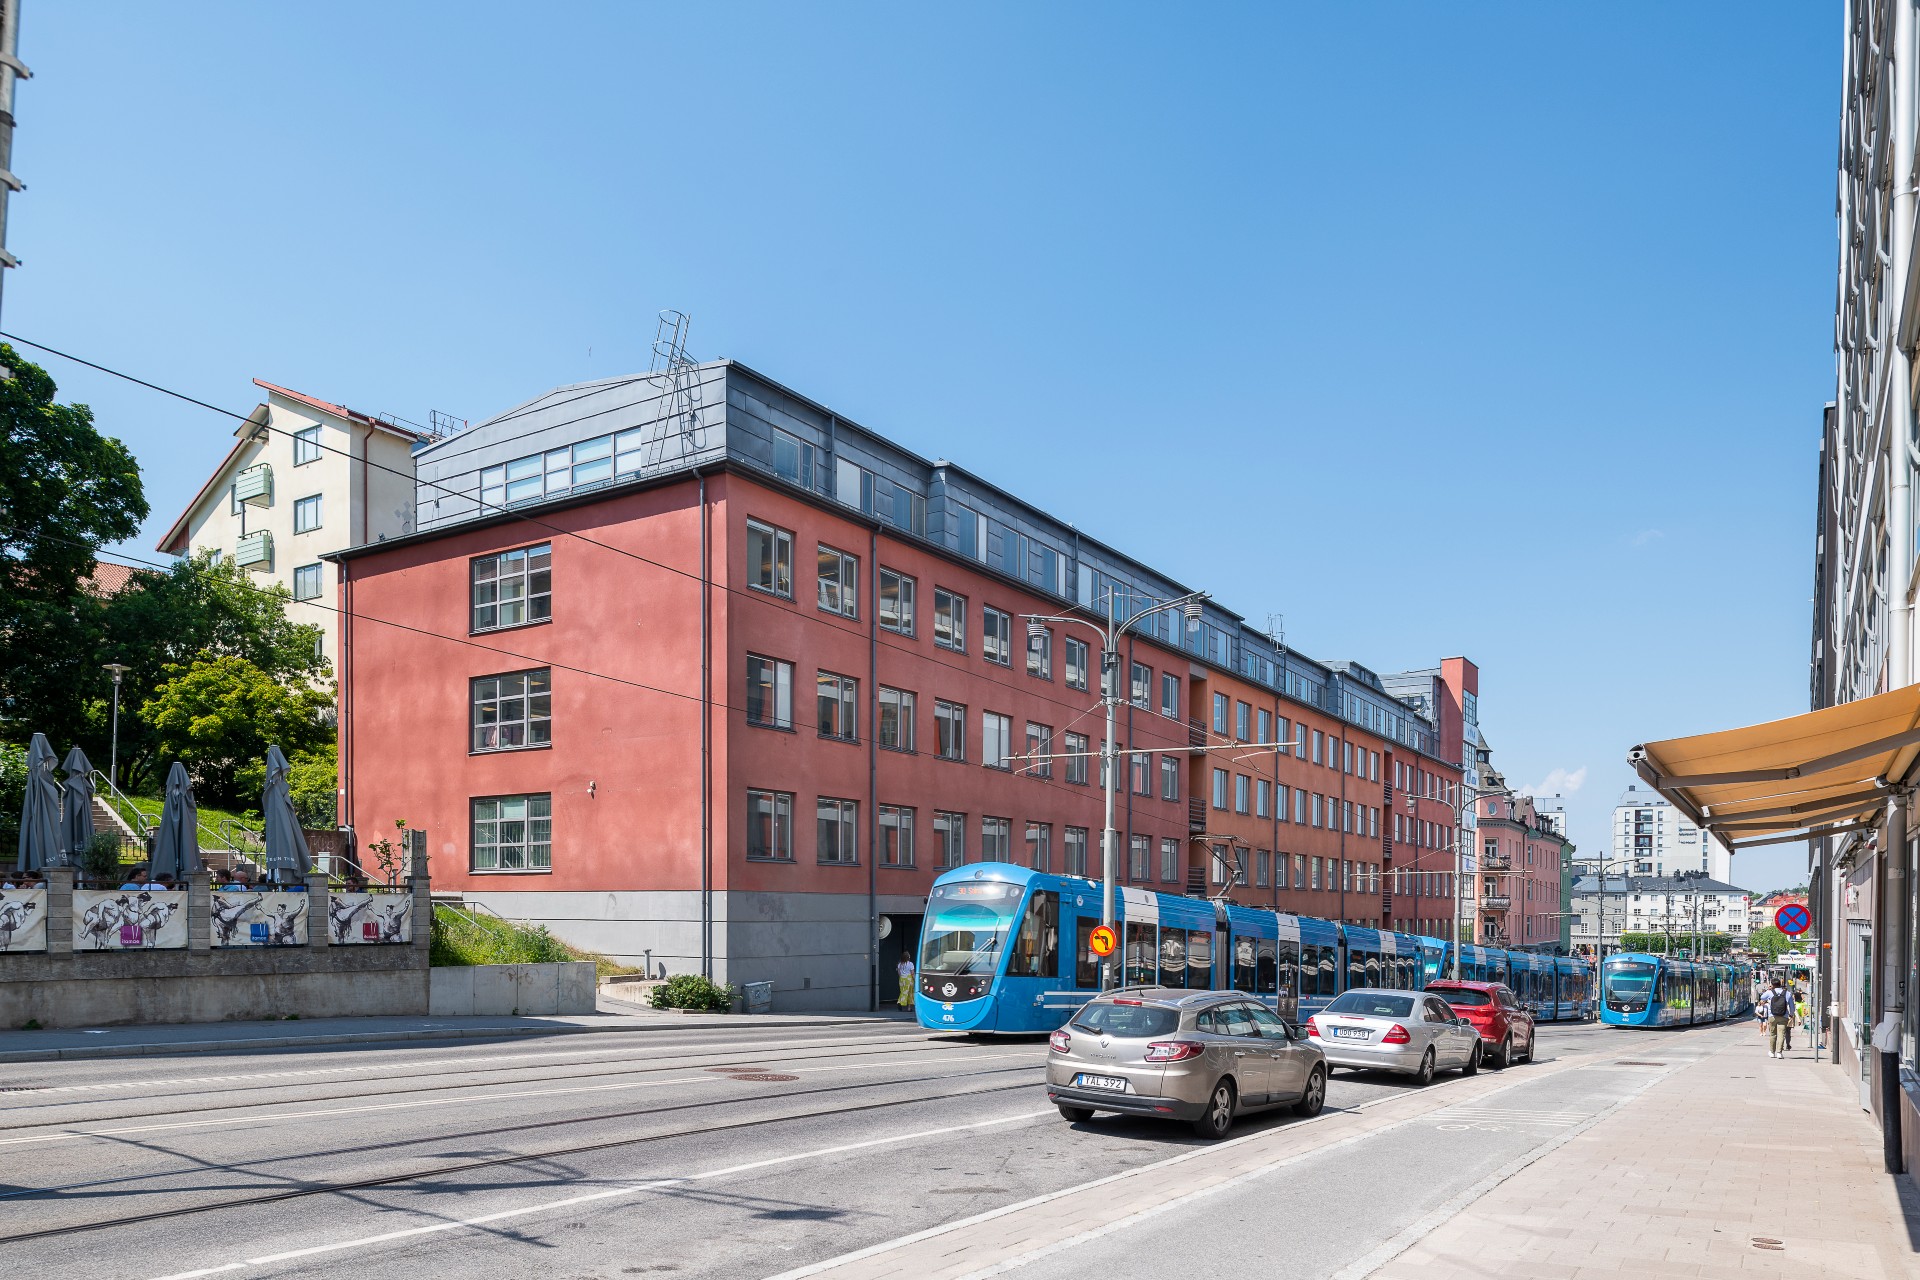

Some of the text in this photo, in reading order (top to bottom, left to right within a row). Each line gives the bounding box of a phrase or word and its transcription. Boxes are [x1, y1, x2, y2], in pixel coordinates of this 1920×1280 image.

[942, 1013, 955, 1022] 476
[1085, 1075, 1122, 1089] YAL 392
